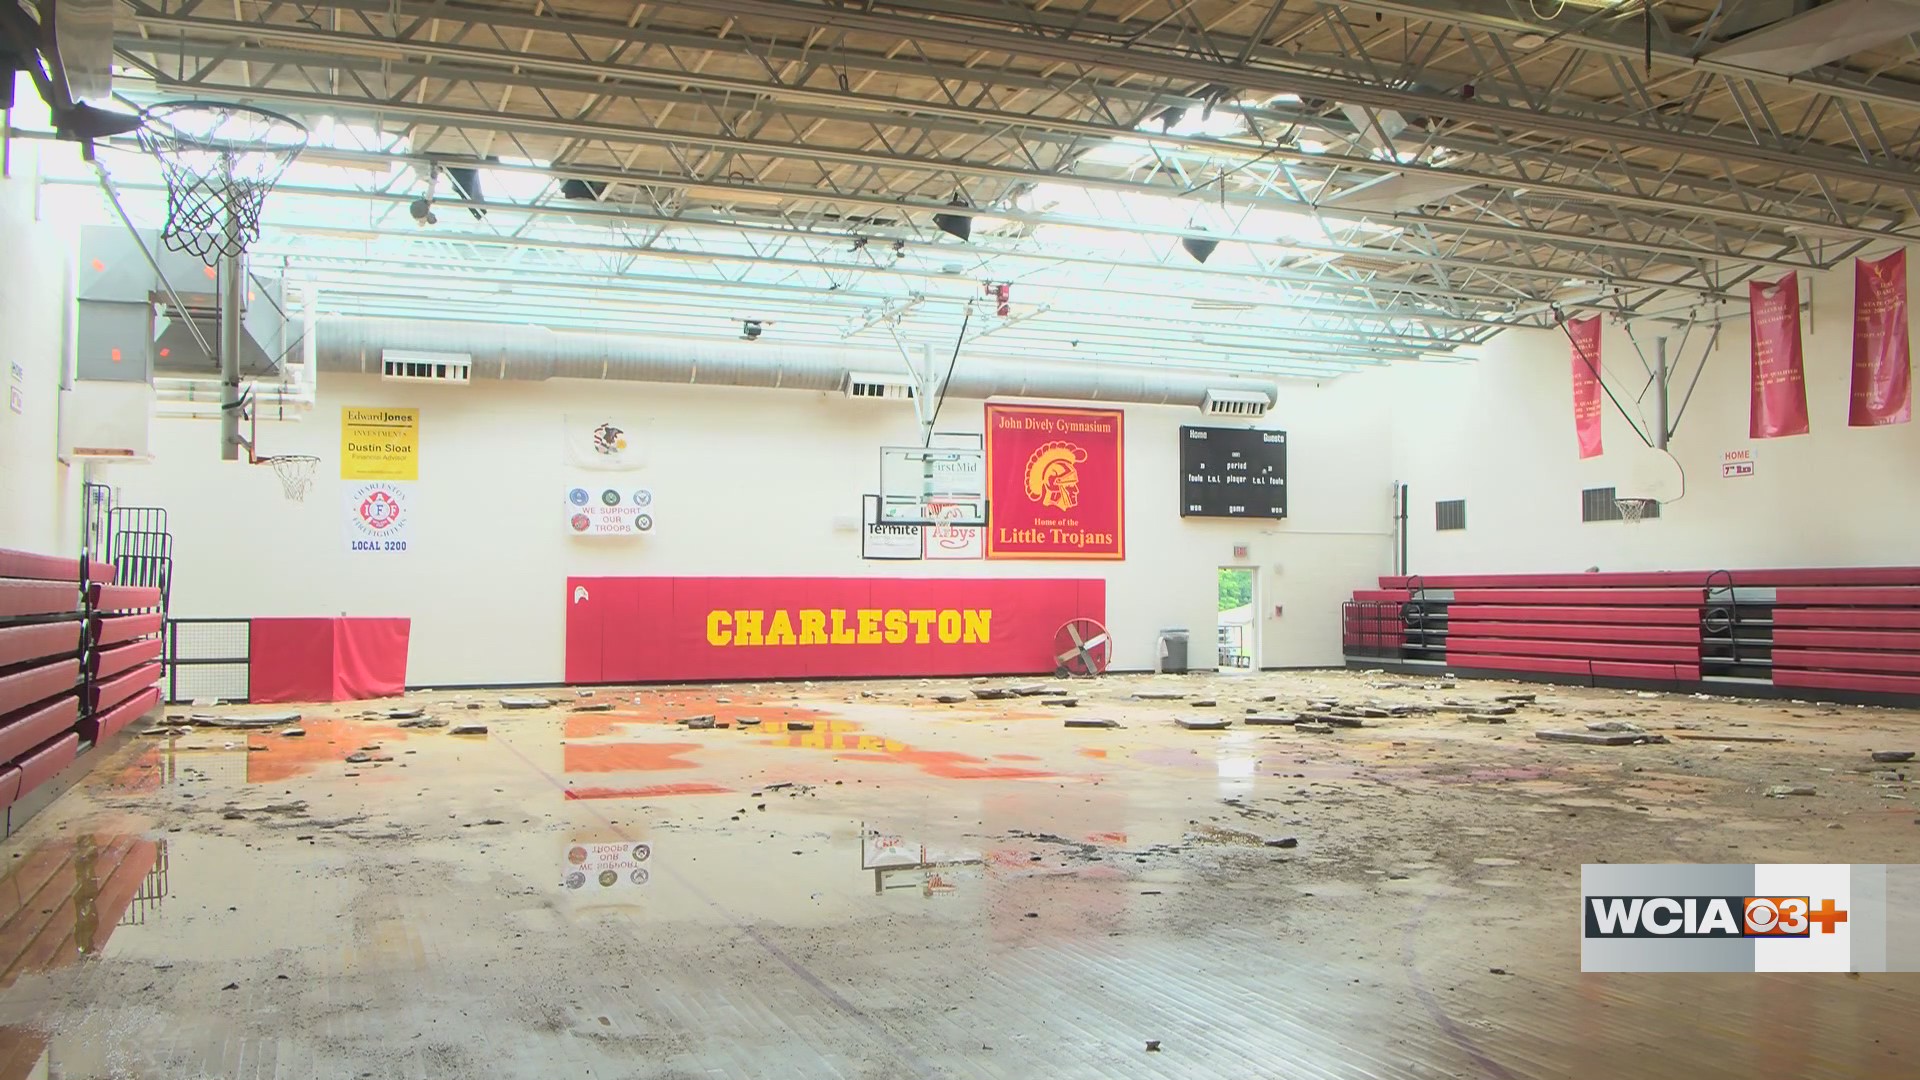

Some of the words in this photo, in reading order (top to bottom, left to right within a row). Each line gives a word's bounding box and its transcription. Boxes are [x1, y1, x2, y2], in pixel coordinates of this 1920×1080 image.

[348, 411, 383, 421] Edward
[384, 412, 413, 422] Jones
[999, 416, 1022, 429] John
[1025, 417, 1054, 433] Dively
[1057, 418, 1111, 434] Gymnasium
[348, 442, 382, 452] Dustin
[385, 443, 411, 453] Sloat
[1725, 450, 1750, 460] HOME
[957, 462, 977, 472] Mid
[1226, 462, 1247, 471] period
[1226, 475, 1247, 484] player
[1228, 506, 1245, 514] game
[602, 516, 622, 524] OUR
[1034, 518, 1056, 526] Home
[1058, 518, 1067, 526] of
[1067, 518, 1079, 526] the
[595, 525, 631, 533] TROOPS
[868, 522, 919, 535] Termite
[1000, 528, 1046, 544] Little
[1049, 528, 1113, 548] Trojans
[352, 540, 381, 551] LOCAL
[384, 541, 407, 551] 3200
[706, 609, 992, 646] CHARLESTON
